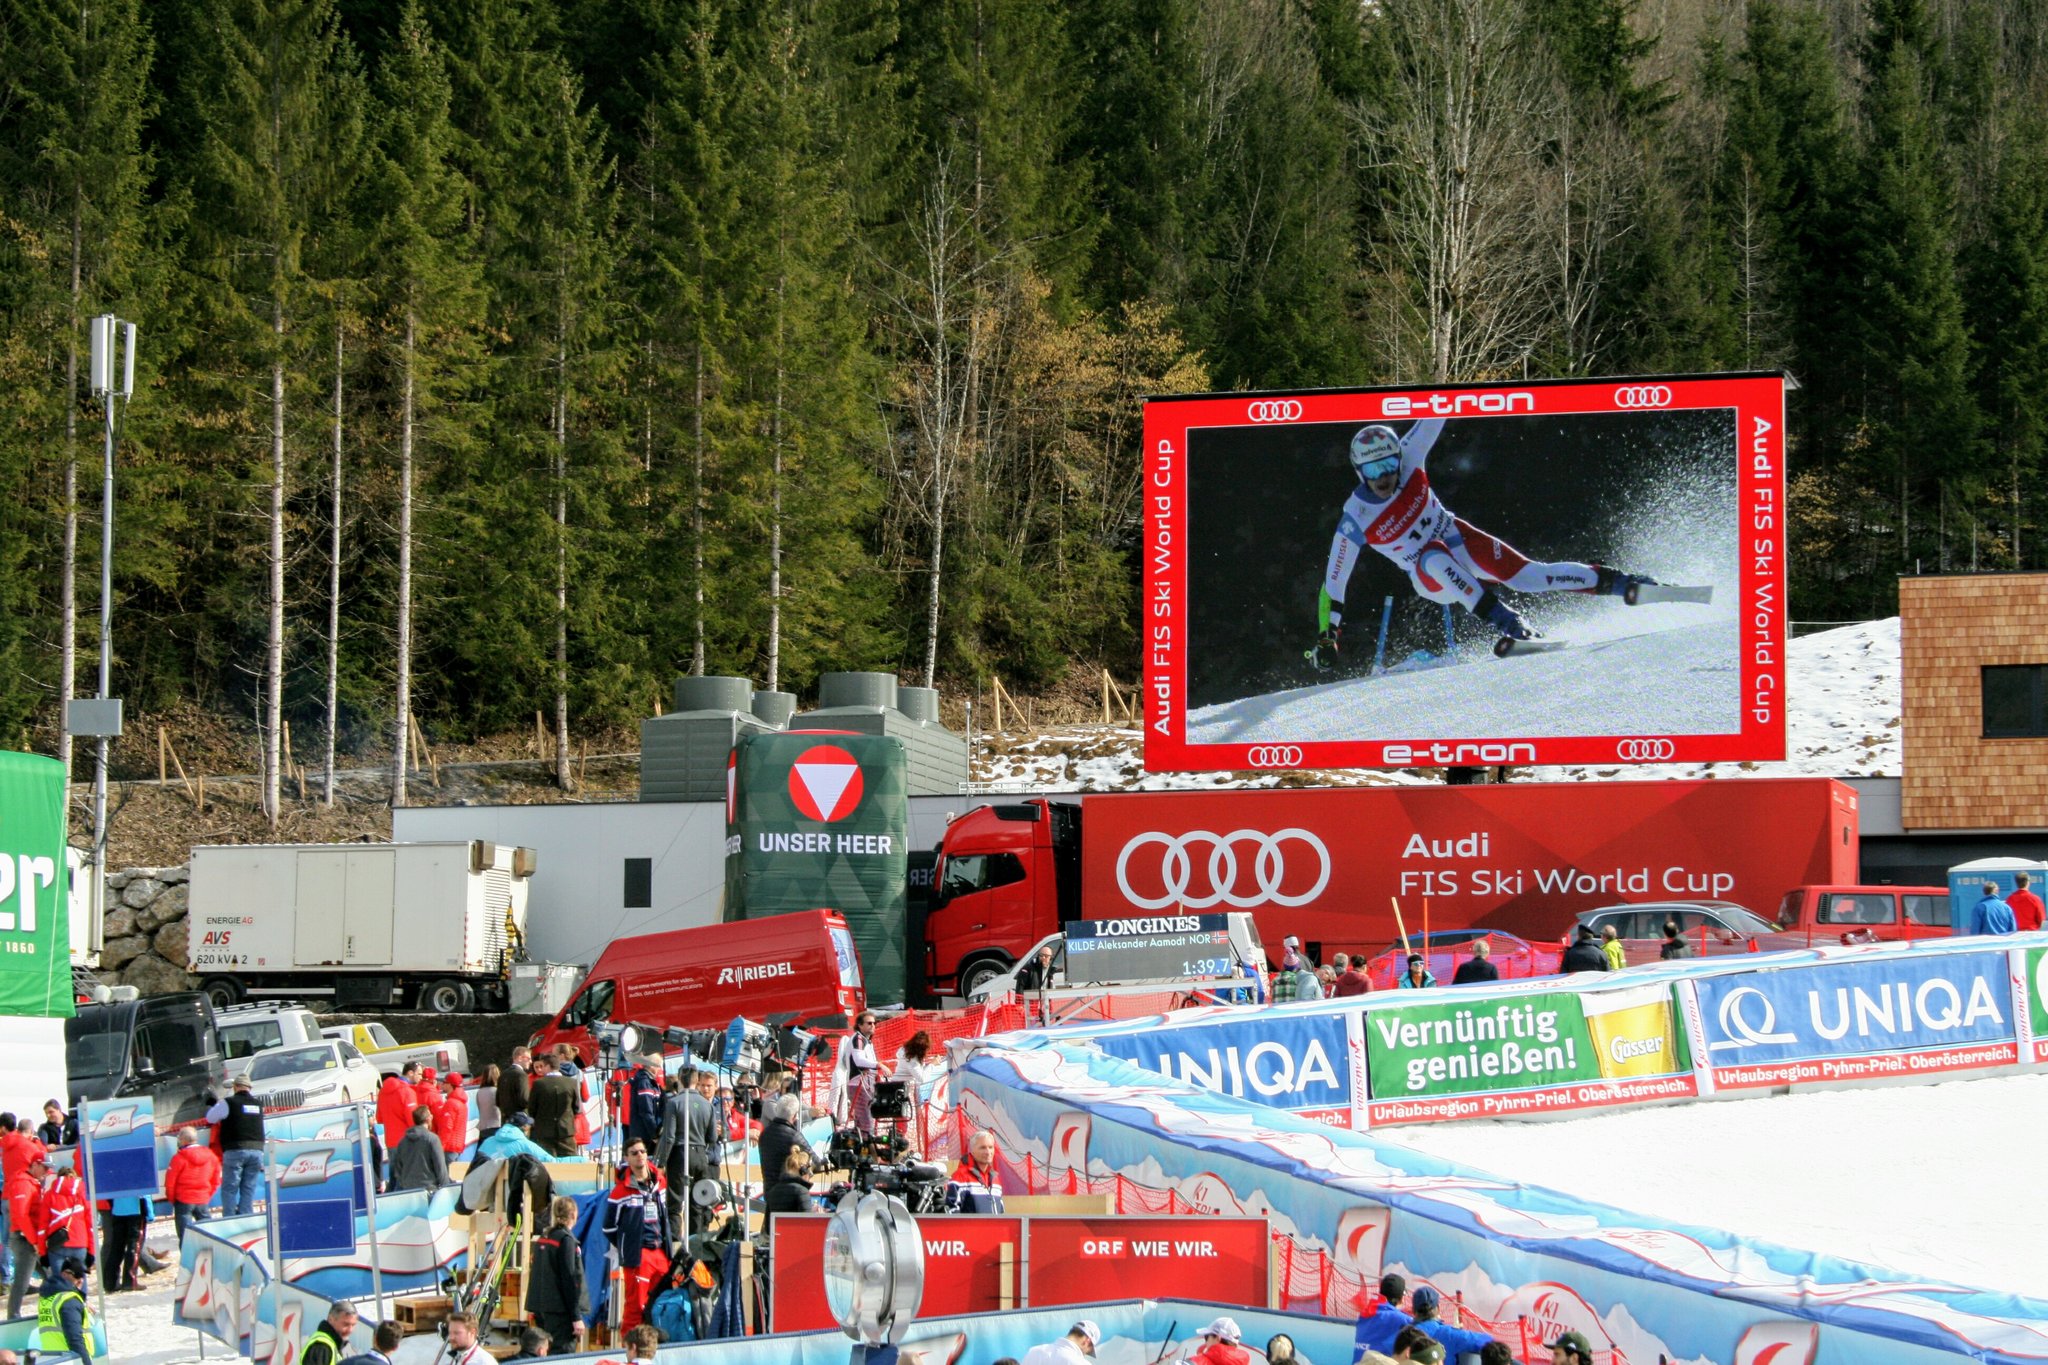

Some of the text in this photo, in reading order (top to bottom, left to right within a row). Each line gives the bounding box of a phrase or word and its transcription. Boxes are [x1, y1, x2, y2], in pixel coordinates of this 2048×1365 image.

[1382, 392, 1534, 416] e-tron
[1375, 515, 1396, 536] ober
[1408, 517, 1432, 541] 14
[1331, 538, 1348, 581] RAIFFEISEN
[1752, 416, 1774, 724] Audi FIS Ski World Cup
[1154, 440, 1174, 736] Audi FIS Ski World Cup
[1444, 566, 1467, 590] BKW
[1382, 743, 1536, 764] e-tron
[759, 832, 892, 854] UNSER HEER
[1402, 832, 1490, 858] Audi
[1400, 866, 1734, 898] FIS Ski World Cup
[202, 931, 232, 944] AVS
[1095, 916, 1200, 936] LONGINES
[6, 942, 35, 954] 1860
[1068, 934, 1211, 951] KILDE Aleksander Aamodt NOR
[197, 954, 248, 964] 620 kVA 2
[1183, 958, 1230, 976] 1:39.7
[744, 962, 796, 981] RIEDEL
[1808, 976, 2004, 1040] UNIQA
[1376, 1004, 1558, 1050] Vernünftig
[1610, 1035, 1662, 1064] Gösser
[1406, 1038, 1577, 1091] genießen!
[1718, 1066, 1818, 1085] Urlaubsregion
[1823, 1057, 1907, 1080] Pyhrn-Priel.
[1910, 1046, 2016, 1070] Oberösterreich.
[1374, 1079, 1690, 1121] Urlaubsregion Pyhrn-Priel. Oberösterreich.
[926, 1240, 970, 1256] WIR.
[1083, 1240, 1218, 1256] ORF WIE WIR.
